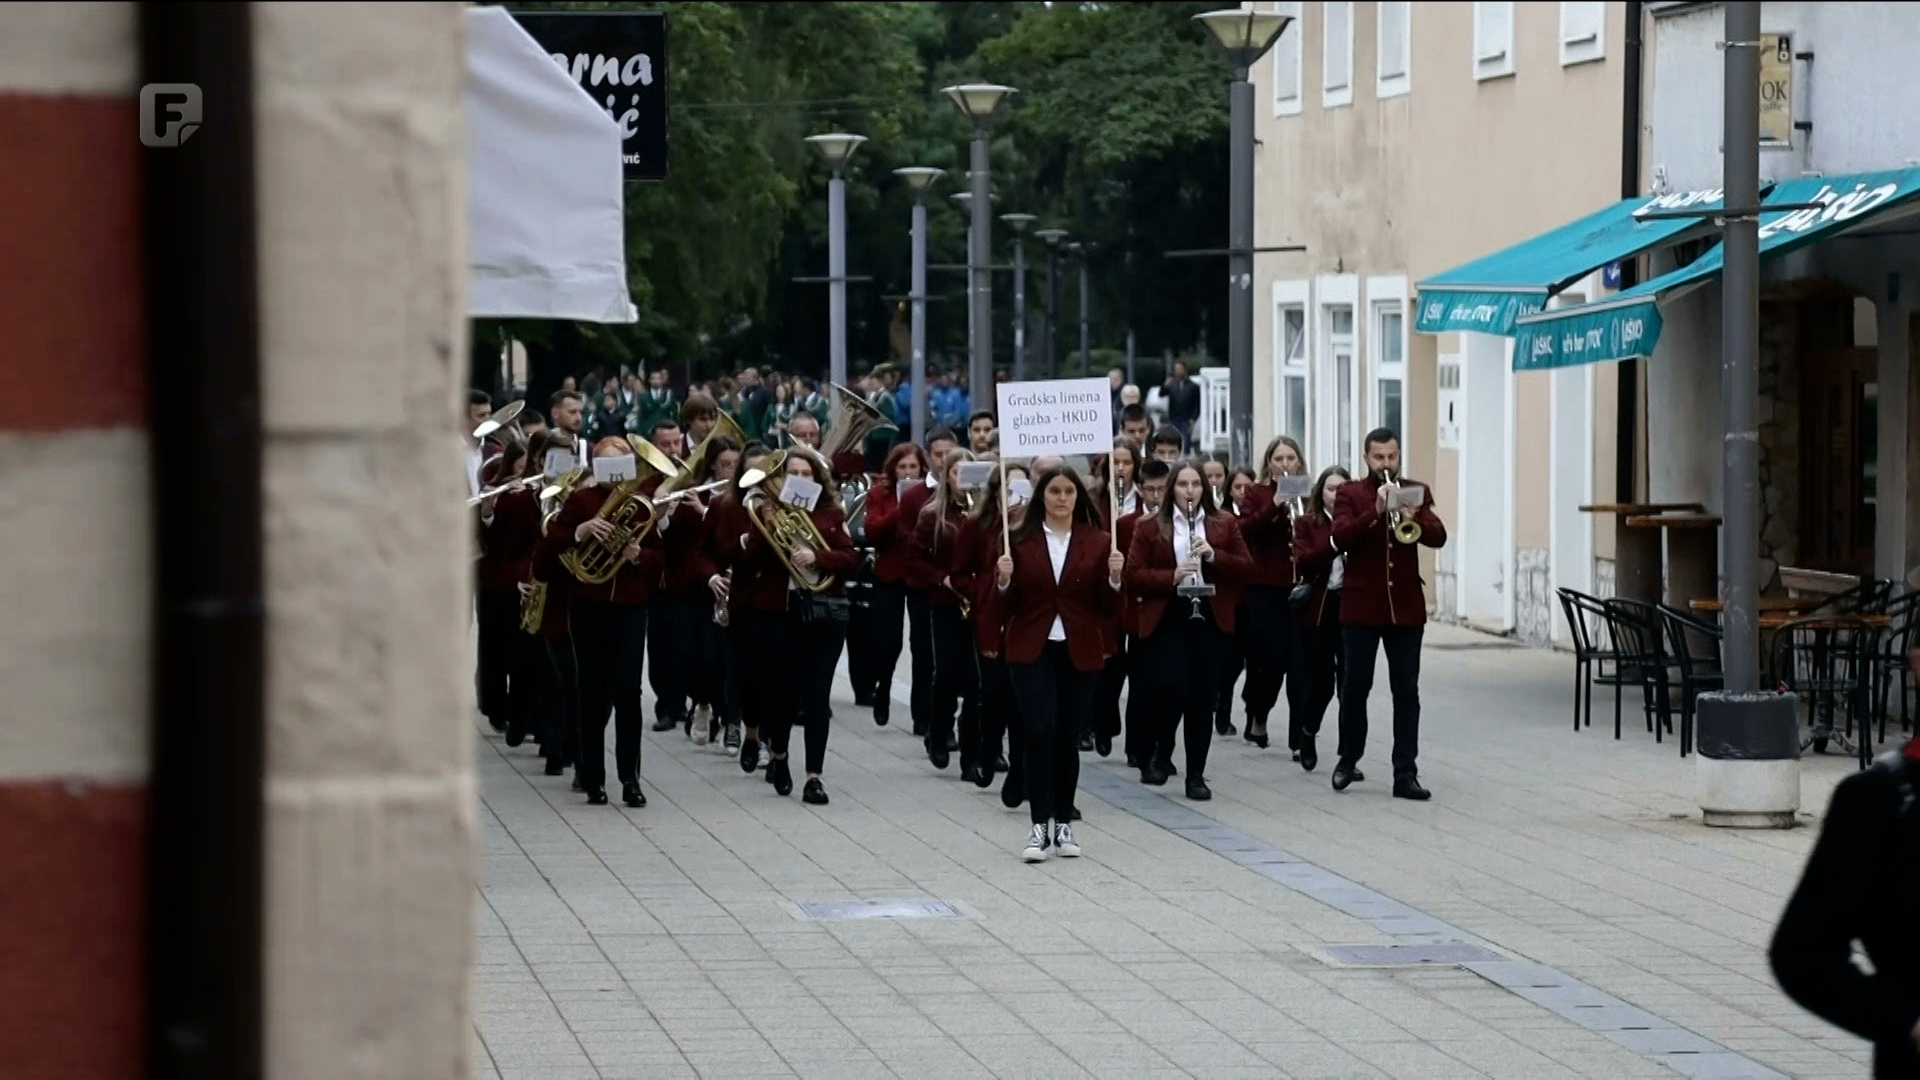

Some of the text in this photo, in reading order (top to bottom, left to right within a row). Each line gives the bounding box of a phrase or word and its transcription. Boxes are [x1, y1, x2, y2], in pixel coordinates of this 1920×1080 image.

[1008, 391, 1101, 407] Gradska limena
[1012, 411, 1051, 430] glazba
[1062, 409, 1098, 424] HKUD
[1018, 431, 1095, 446] Dinara Livno
